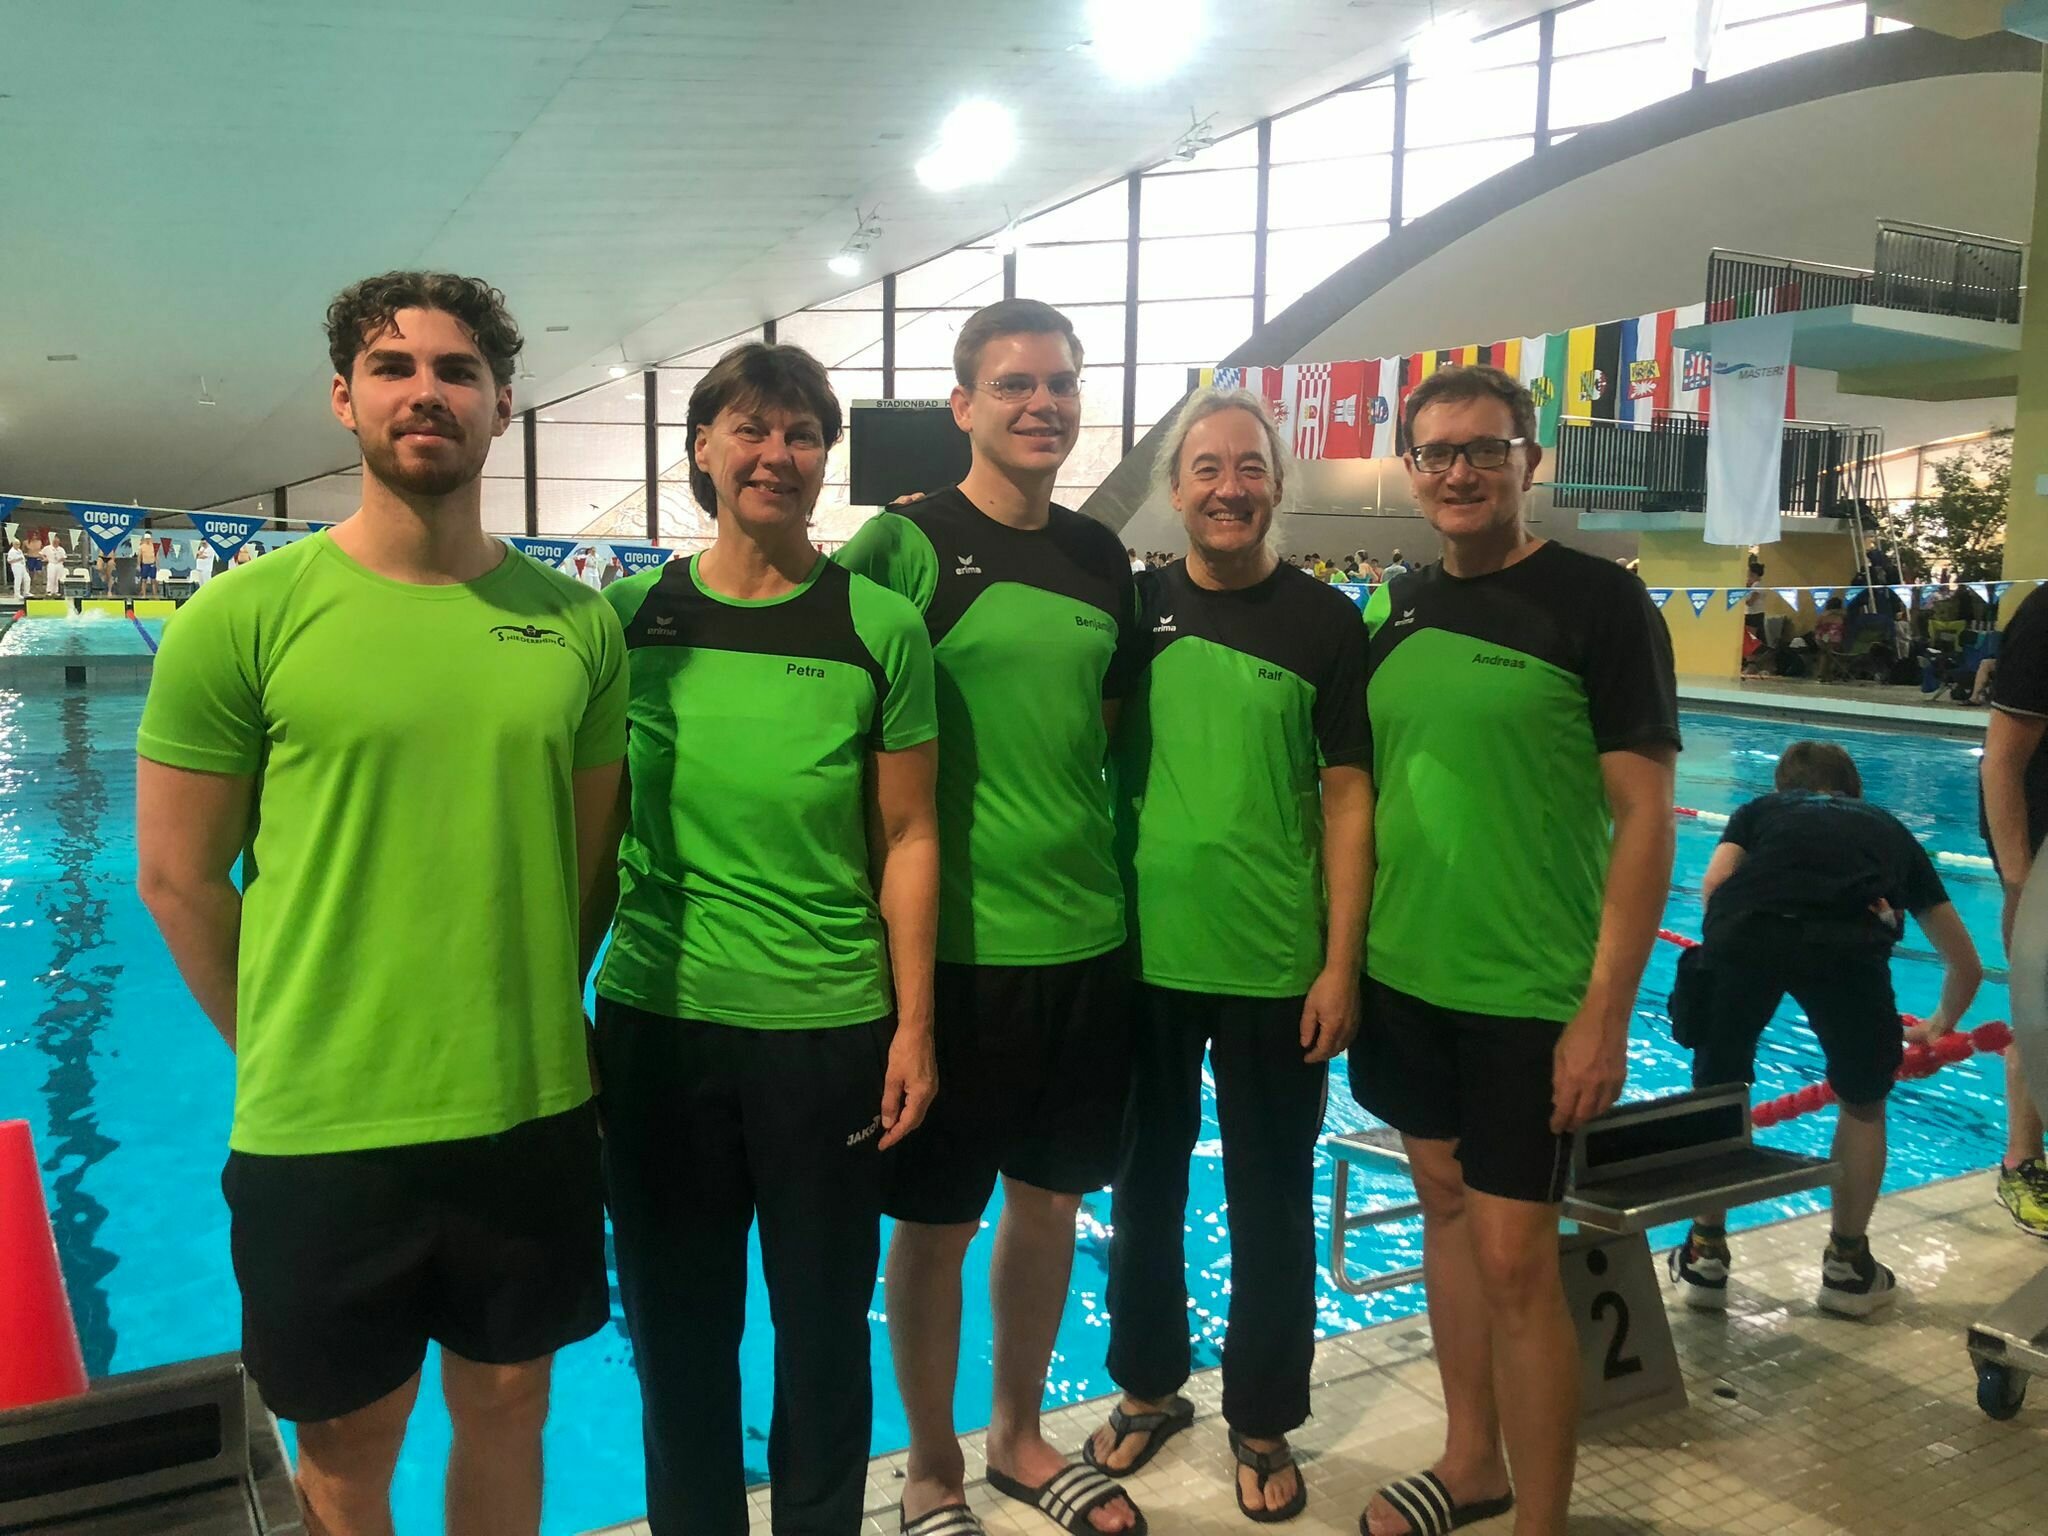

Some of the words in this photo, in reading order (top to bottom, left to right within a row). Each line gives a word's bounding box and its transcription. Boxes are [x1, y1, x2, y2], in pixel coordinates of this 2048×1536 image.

[876, 400, 939, 408] STADIONBAD
[83, 510, 130, 526] arena
[204, 520, 248, 535] arena
[525, 544, 562, 558] arena
[624, 551, 660, 564] arena
[955, 565, 982, 575] erima
[1153, 624, 1177, 633] erima
[1471, 653, 1527, 669] Andreas
[786, 663, 825, 678] Petra
[1257, 668, 1283, 681] Ralf
[1590, 1290, 1642, 1381] 2
